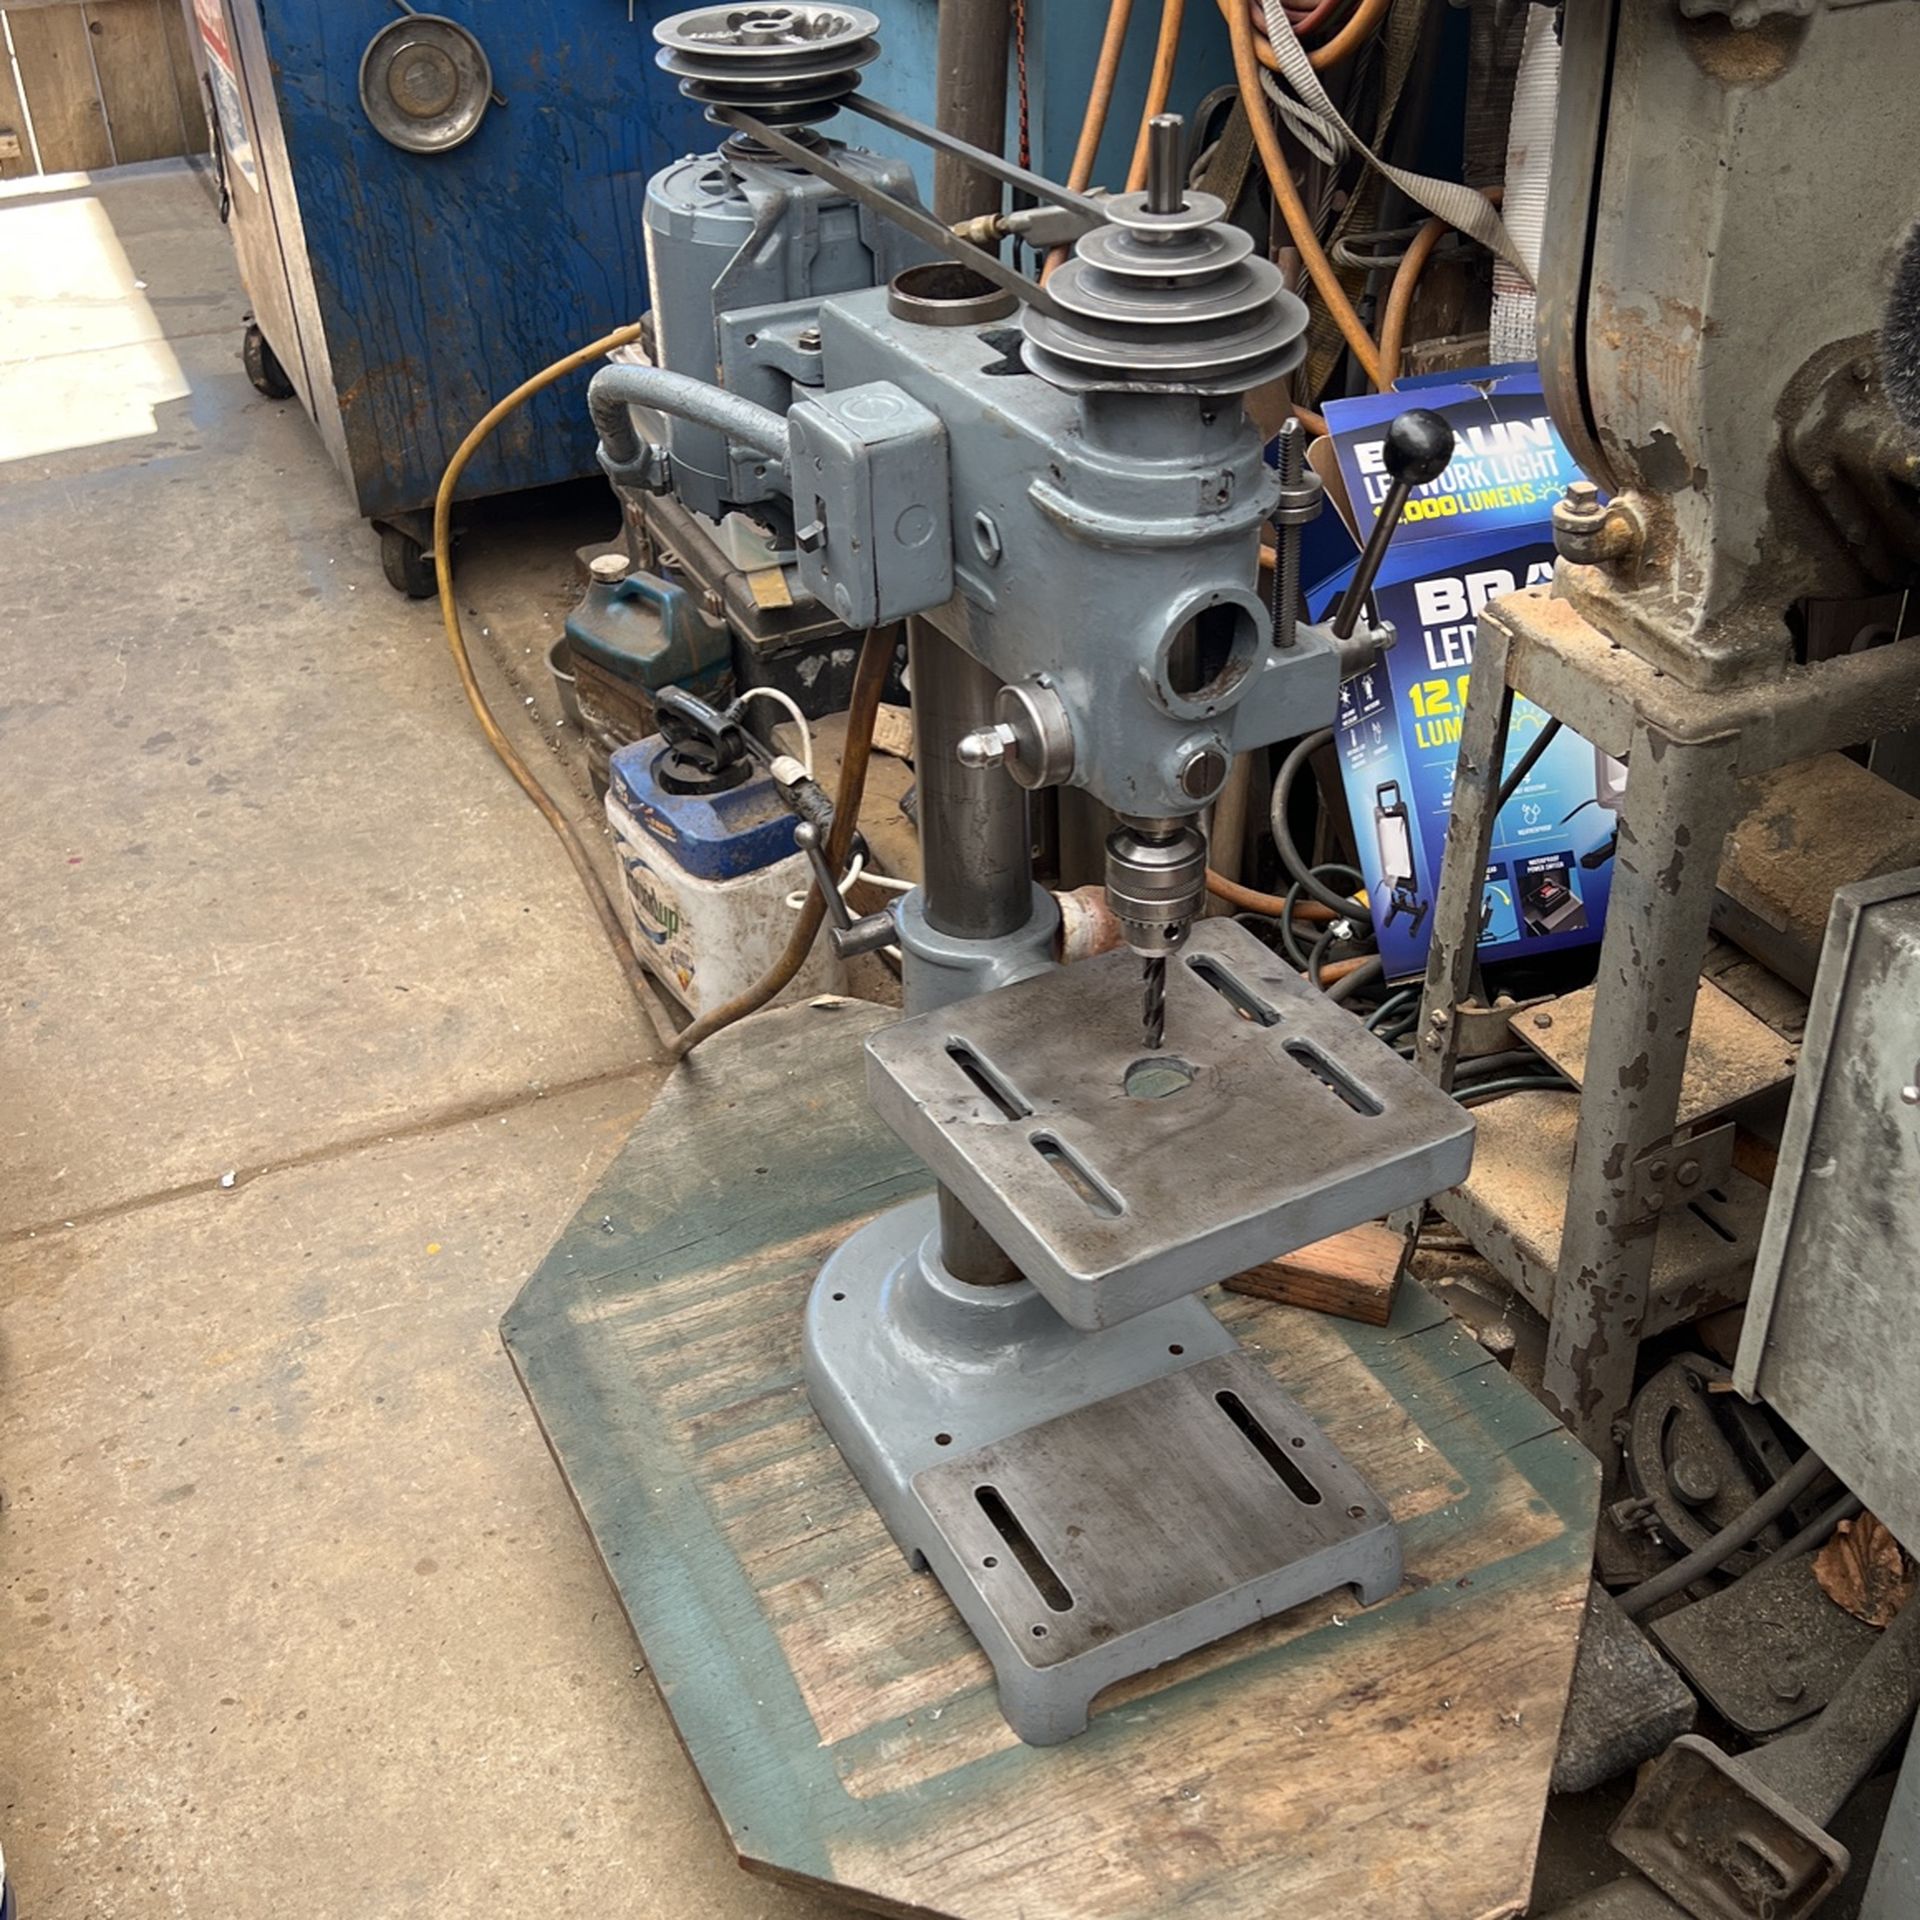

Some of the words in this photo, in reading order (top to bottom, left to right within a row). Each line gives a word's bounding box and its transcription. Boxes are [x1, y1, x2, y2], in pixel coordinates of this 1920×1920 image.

[1353, 416, 1551, 474] BAUN
[1416, 456, 1489, 496] WORK
[1490, 449, 1560, 485] LIGHT
[1373, 495, 1458, 525] ,000
[1457, 482, 1537, 514] LUMENS
